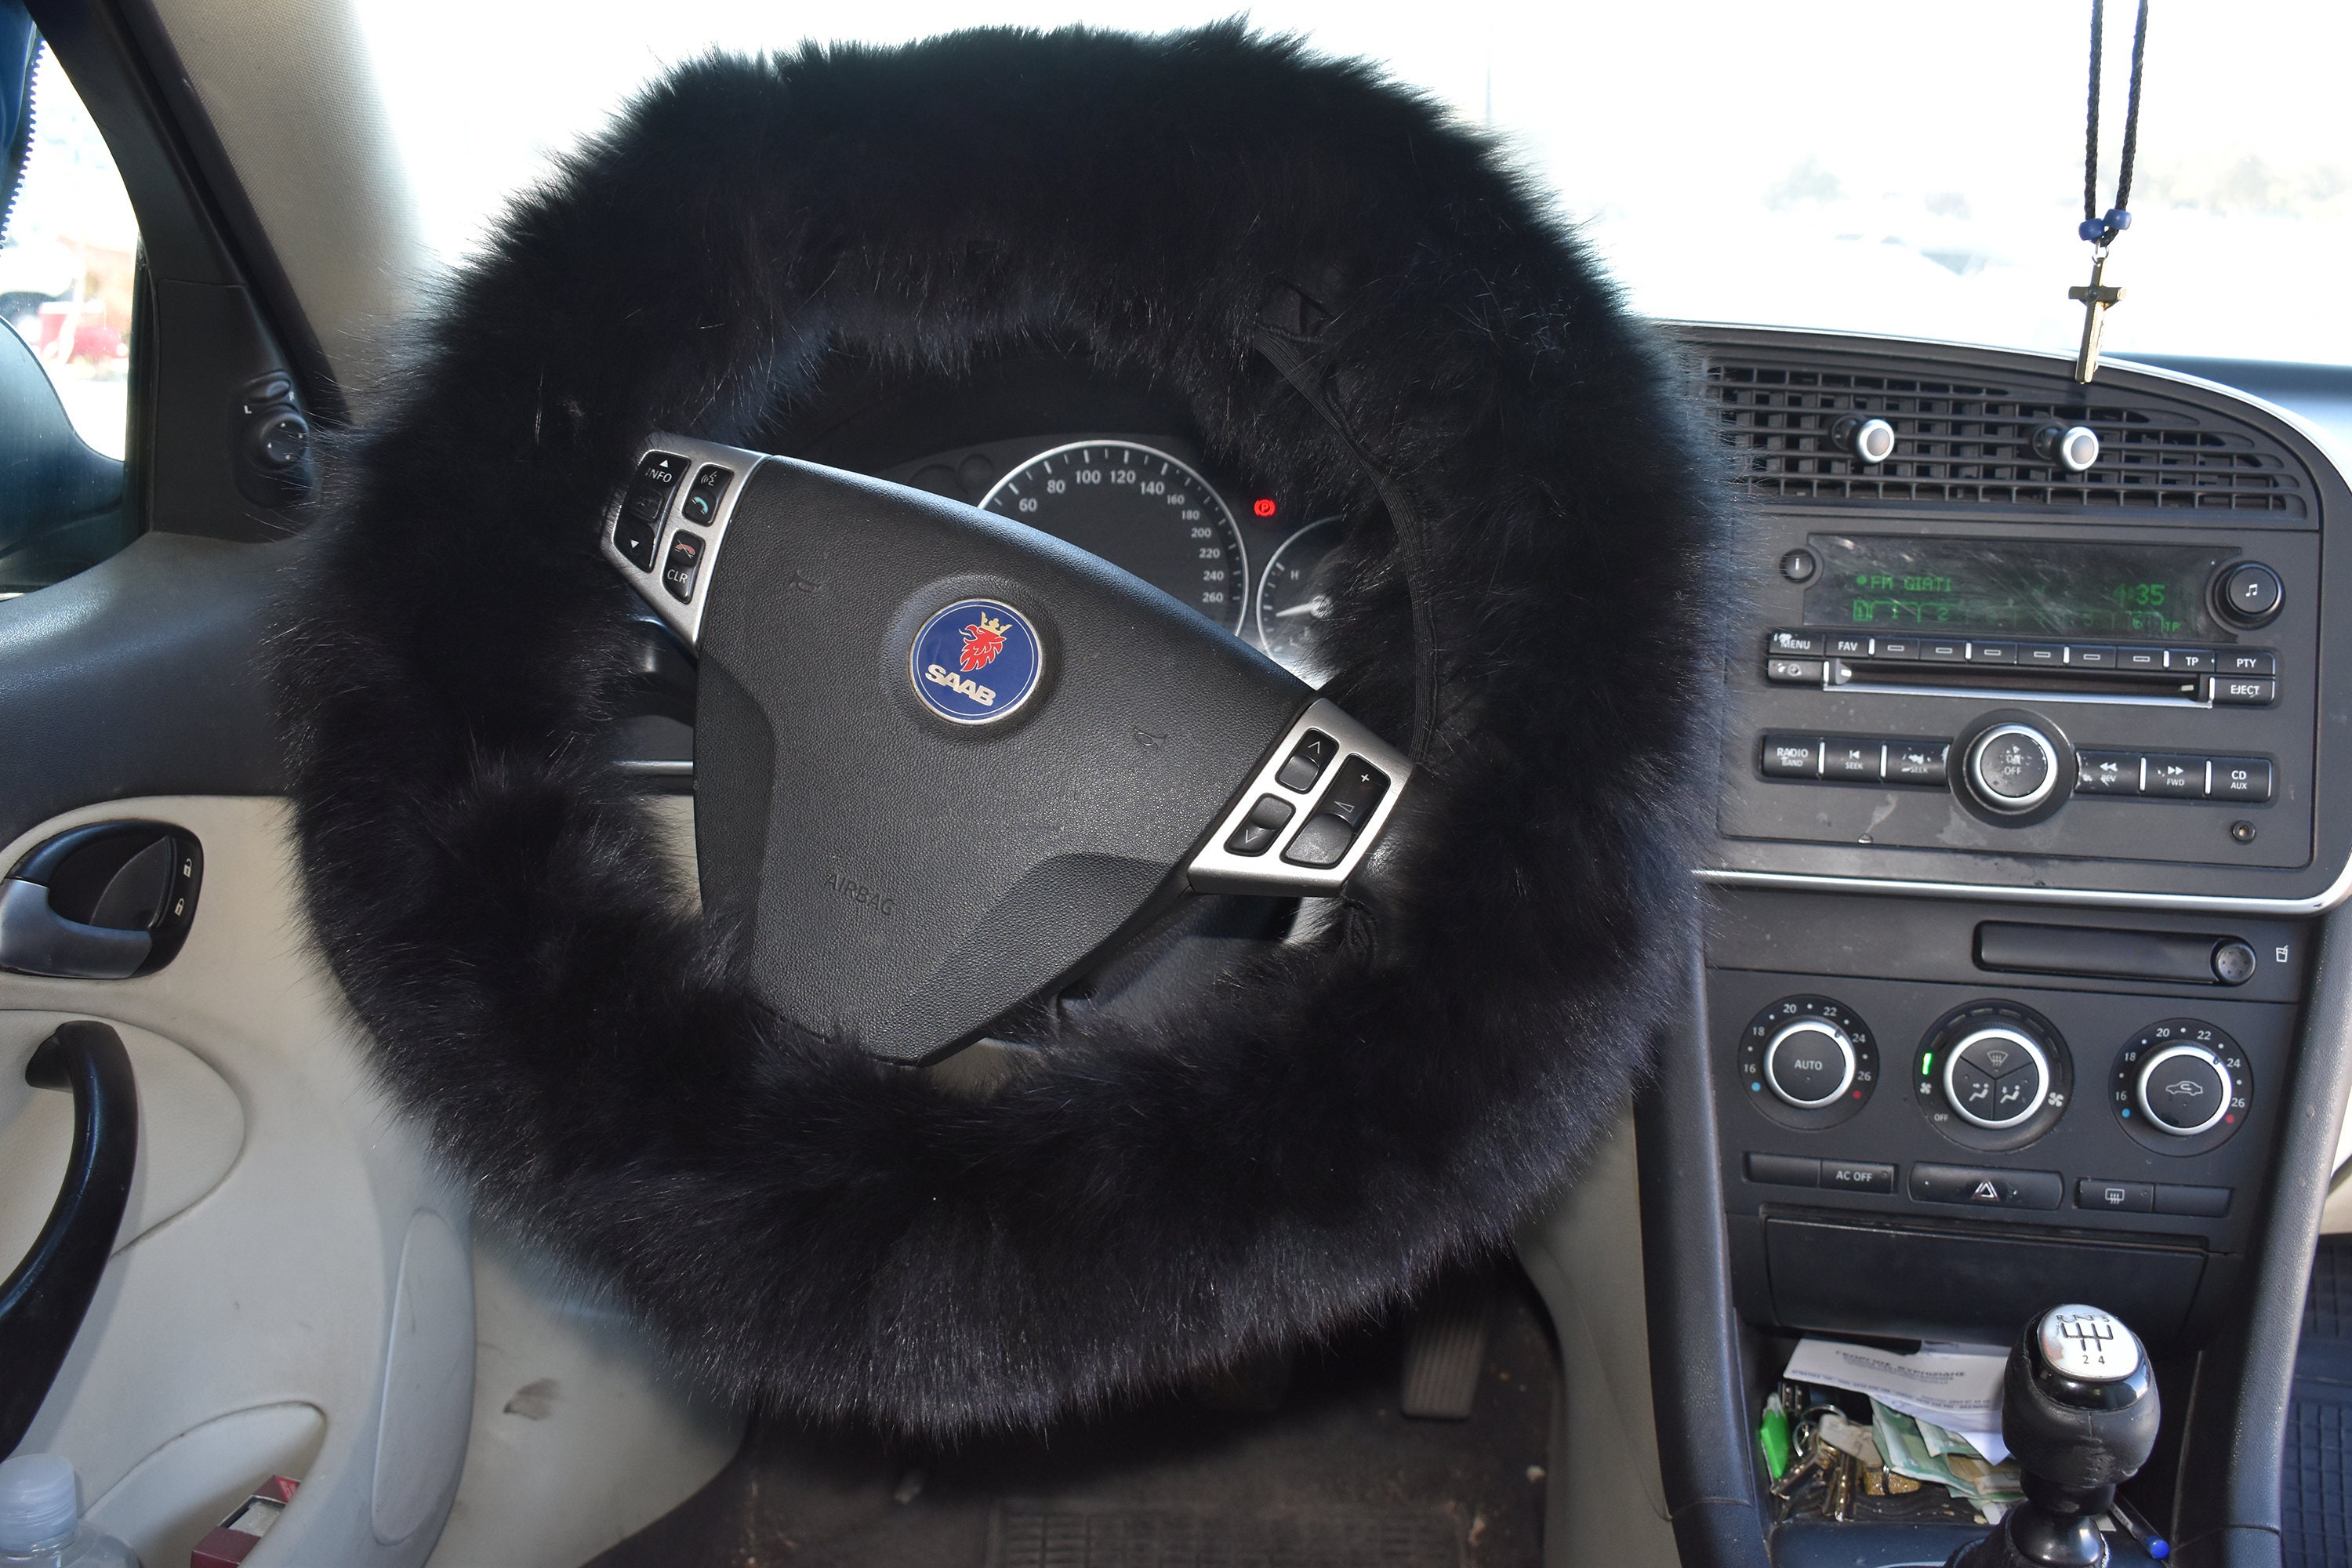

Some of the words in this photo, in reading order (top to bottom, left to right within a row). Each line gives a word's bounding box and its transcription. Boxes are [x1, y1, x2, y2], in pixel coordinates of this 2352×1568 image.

[244, 405, 252, 415] L
[644, 467, 673, 483] INFO
[1076, 470, 1101, 485] 100
[1110, 470, 1136, 485] 120
[1047, 480, 1065, 494] 80
[1140, 481, 1165, 495] 140
[1019, 498, 1038, 512] 60
[1167, 494, 1185, 506] 160
[1181, 510, 1200, 521] 180
[1191, 527, 1212, 538] 200
[1199, 548, 1221, 559] 220
[667, 569, 688, 583] CLR
[1203, 570, 1225, 581] 240
[1290, 570, 1300, 581] H
[1871, 575, 1893, 590] FM
[1203, 592, 1223, 602] 260
[1937, 607, 1950, 621] 2
[1780, 639, 1811, 649] MENU
[1838, 641, 1858, 652] FAV
[2186, 656, 2199, 666] TP
[2237, 659, 2256, 668] PTY
[925, 664, 996, 706] SAAB
[2230, 685, 2260, 695] EJECT
[1777, 747, 1809, 758] RADIO
[1781, 759, 1803, 768] BAND
[2004, 766, 2022, 775] OFF
[2231, 770, 2247, 780] CD
[1783, 1004, 1797, 1014] 20
[1823, 1007, 1838, 1017] 22
[1752, 1027, 1765, 1036] 18
[2156, 1028, 2170, 1037] 20
[2197, 1030, 2212, 1040] 22
[1852, 1033, 1866, 1043] 24
[2125, 1052, 2136, 1062] 18
[1794, 1059, 1823, 1070] AUTO
[2226, 1058, 2241, 1068] 24
[1744, 1064, 1756, 1073] 16
[1857, 1071, 1871, 1081] 26
[2115, 1091, 2127, 1101] 16
[2230, 1098, 2245, 1108] 26
[1934, 1113, 1948, 1122] OFF
[1835, 1170, 1850, 1181] AC
[1853, 1171, 1873, 1182] OFF
[2082, 1355, 2089, 1364] 2
[2098, 1356, 2106, 1365] 4
